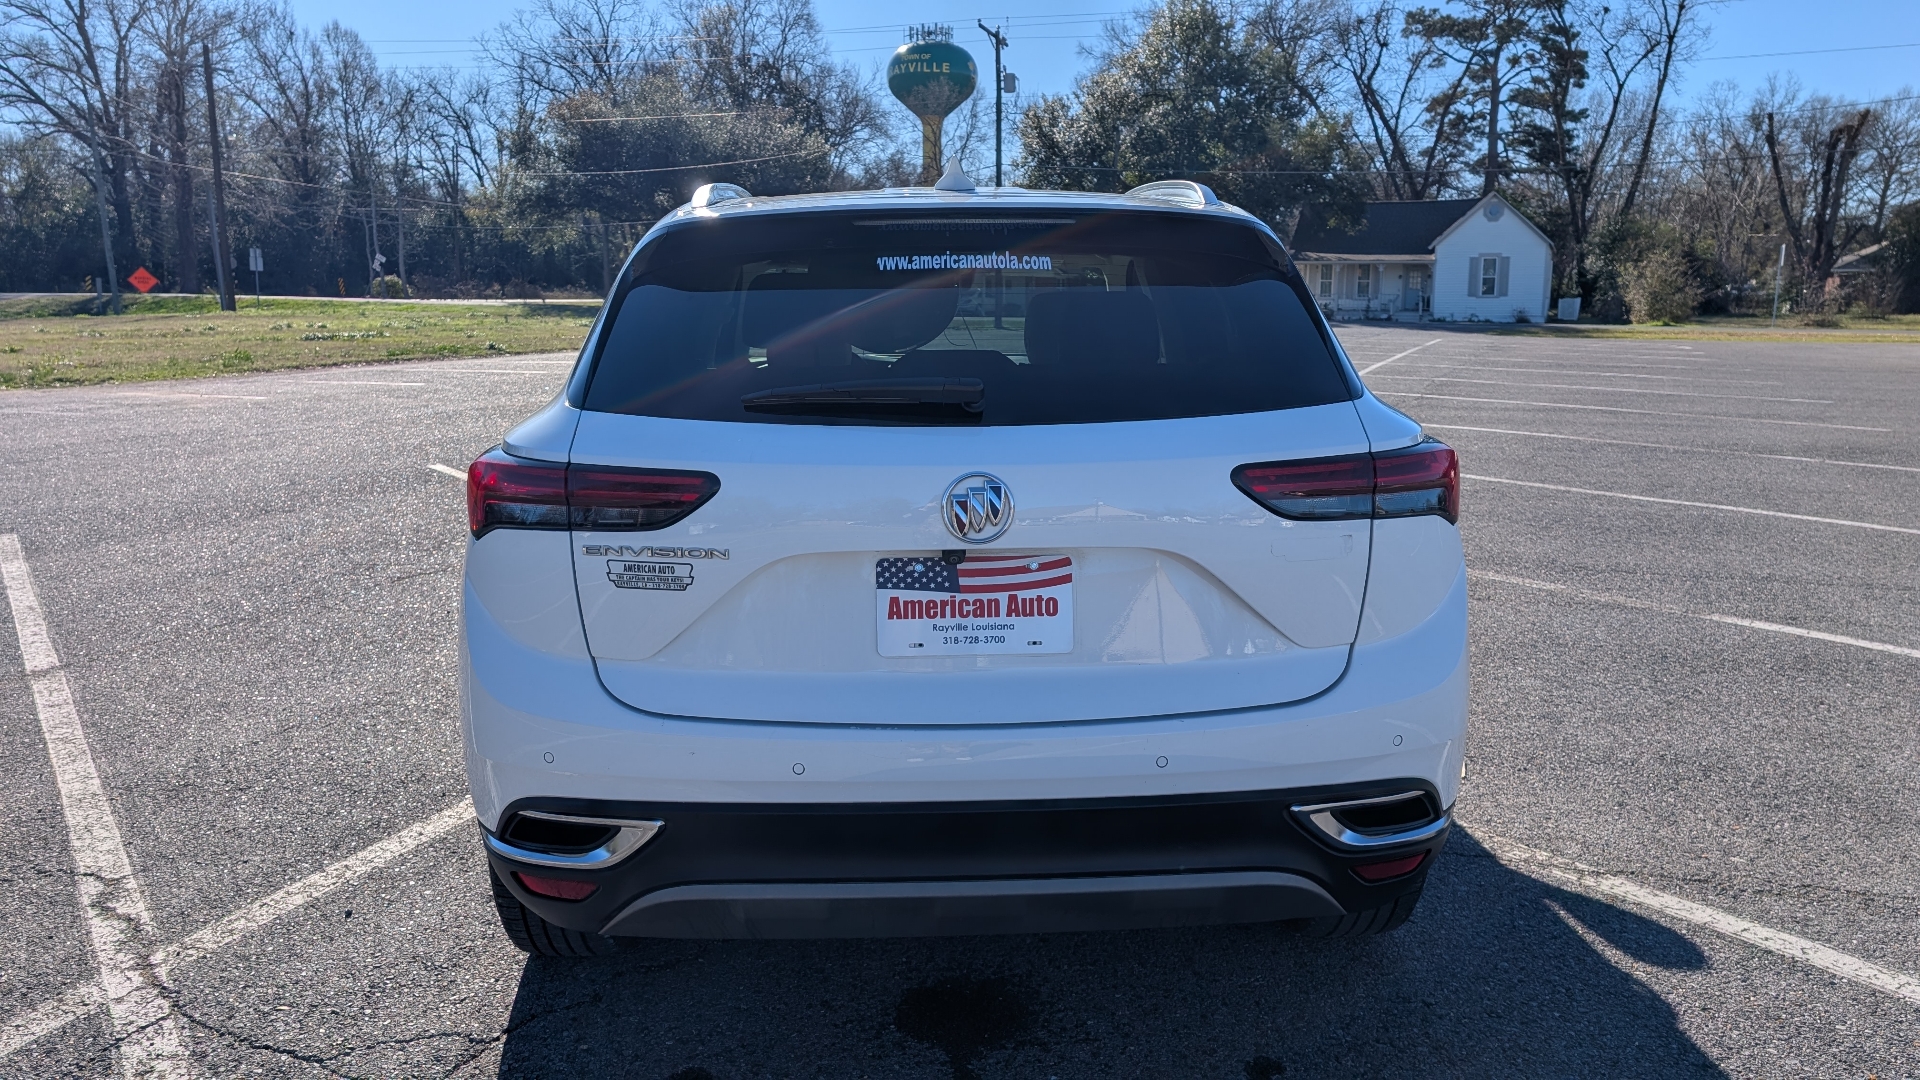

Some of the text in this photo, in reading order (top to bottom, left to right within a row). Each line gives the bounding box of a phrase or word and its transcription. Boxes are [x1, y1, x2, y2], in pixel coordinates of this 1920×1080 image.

[876, 250, 1052, 270] www.americanautola.com
[582, 544, 730, 560] ENVISION
[623, 563, 676, 575] AMERICAN AUTO
[888, 594, 1059, 620] American Auto
[932, 622, 1014, 632] Rayville Louisiana
[942, 636, 1006, 645] 318-728-3700
